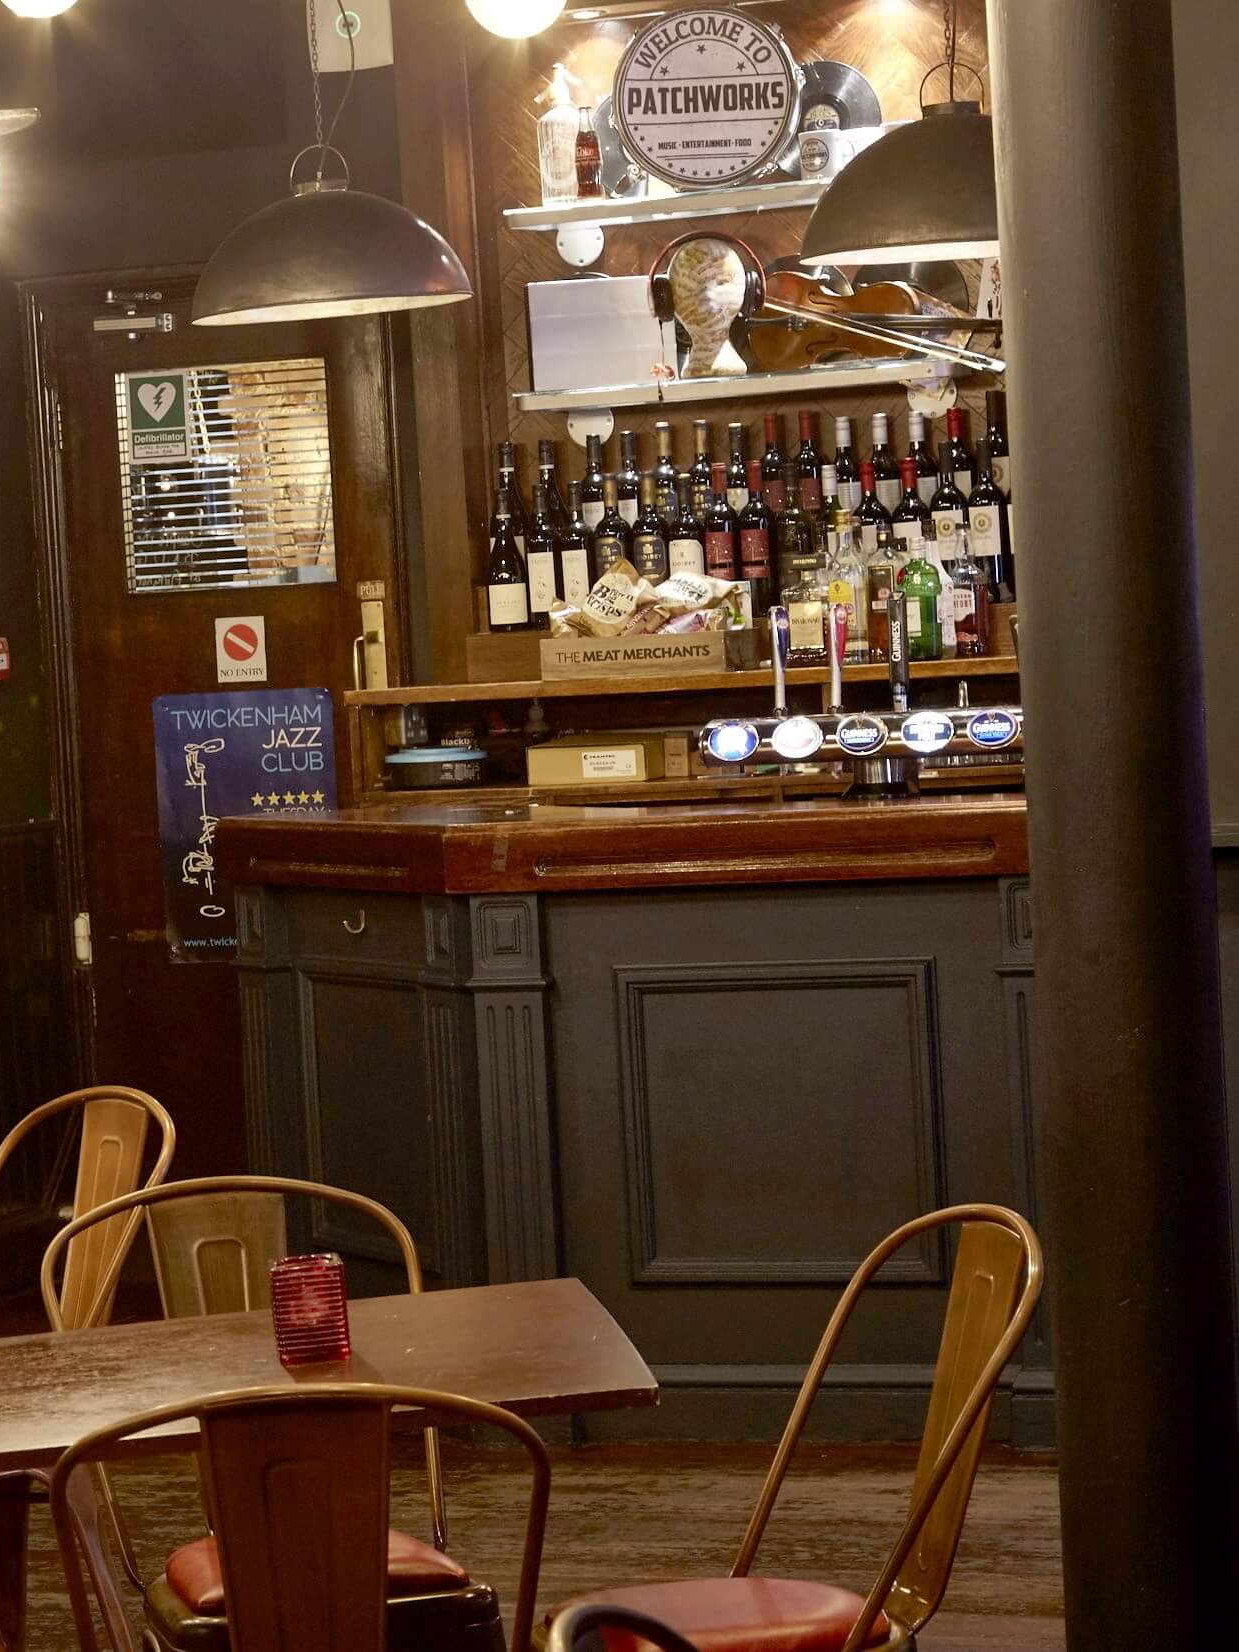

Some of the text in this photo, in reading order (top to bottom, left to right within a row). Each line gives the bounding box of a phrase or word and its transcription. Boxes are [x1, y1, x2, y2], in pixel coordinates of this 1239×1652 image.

[635, 16, 772, 69] WELCOME TO
[628, 81, 784, 115] PATCHWORKS
[658, 138, 752, 150] MUSIC ENTERTAINMENT FOOD
[134, 433, 184, 443] Defibrillator
[891, 621, 901, 662] GUINNESS
[555, 645, 710, 664] THE MEAT MERCHANTS
[220, 667, 264, 678] NO ENTRY
[171, 704, 322, 730] TWICKENHAM
[262, 727, 322, 749] JAZZ
[261, 751, 324, 773] CLUB
